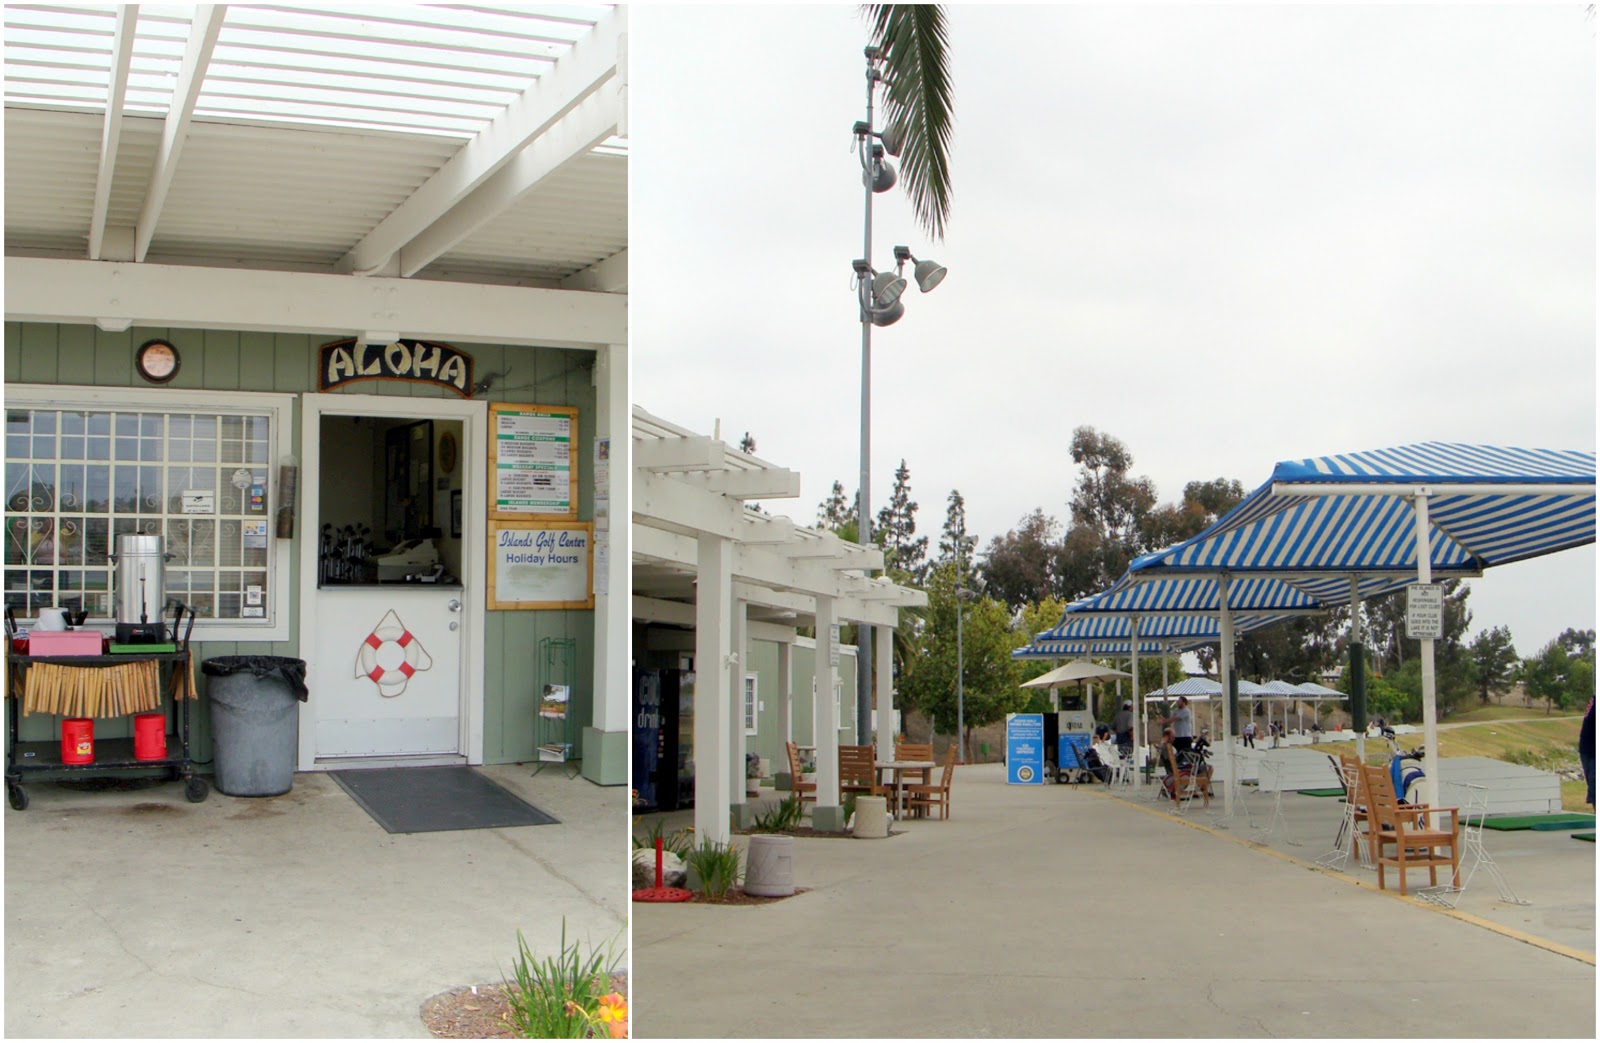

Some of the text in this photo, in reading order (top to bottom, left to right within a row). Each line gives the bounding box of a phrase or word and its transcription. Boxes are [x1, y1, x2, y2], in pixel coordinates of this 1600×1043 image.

[328, 342, 466, 390] ALOHA
[498, 530, 586, 554] Islands Golf Center
[506, 554, 579, 566] Holiday Hours
